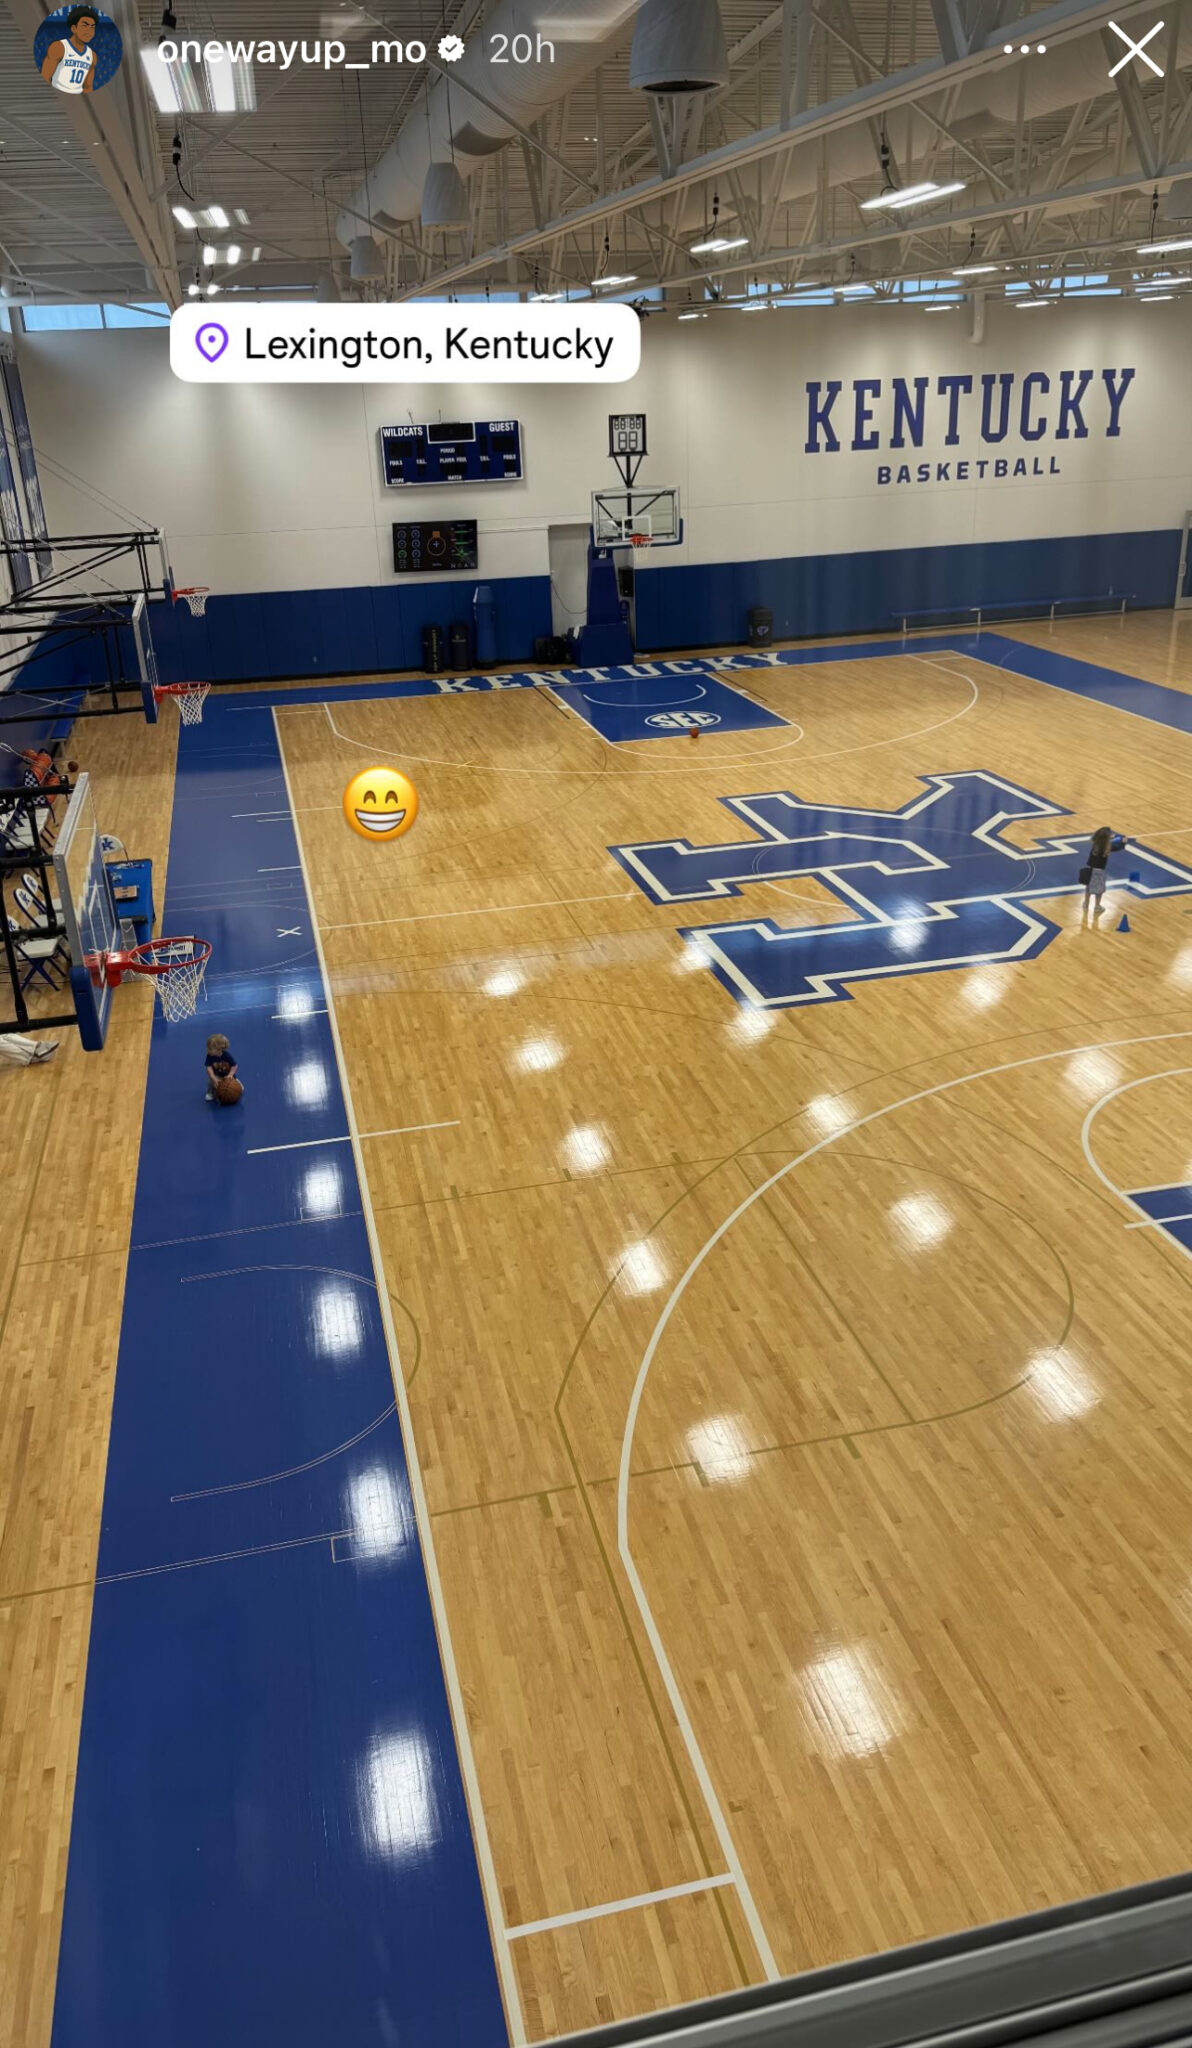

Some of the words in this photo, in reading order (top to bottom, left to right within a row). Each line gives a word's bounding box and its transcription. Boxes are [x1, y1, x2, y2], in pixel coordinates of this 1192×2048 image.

[804, 368, 1136, 454] KENTUCKY
[382, 427, 423, 437] WILDCATS
[489, 422, 515, 432] GUEST
[877, 456, 1061, 485] BASKETBALL
[433, 652, 787, 693] KENTUCKY
[649, 711, 714, 728] SEC
